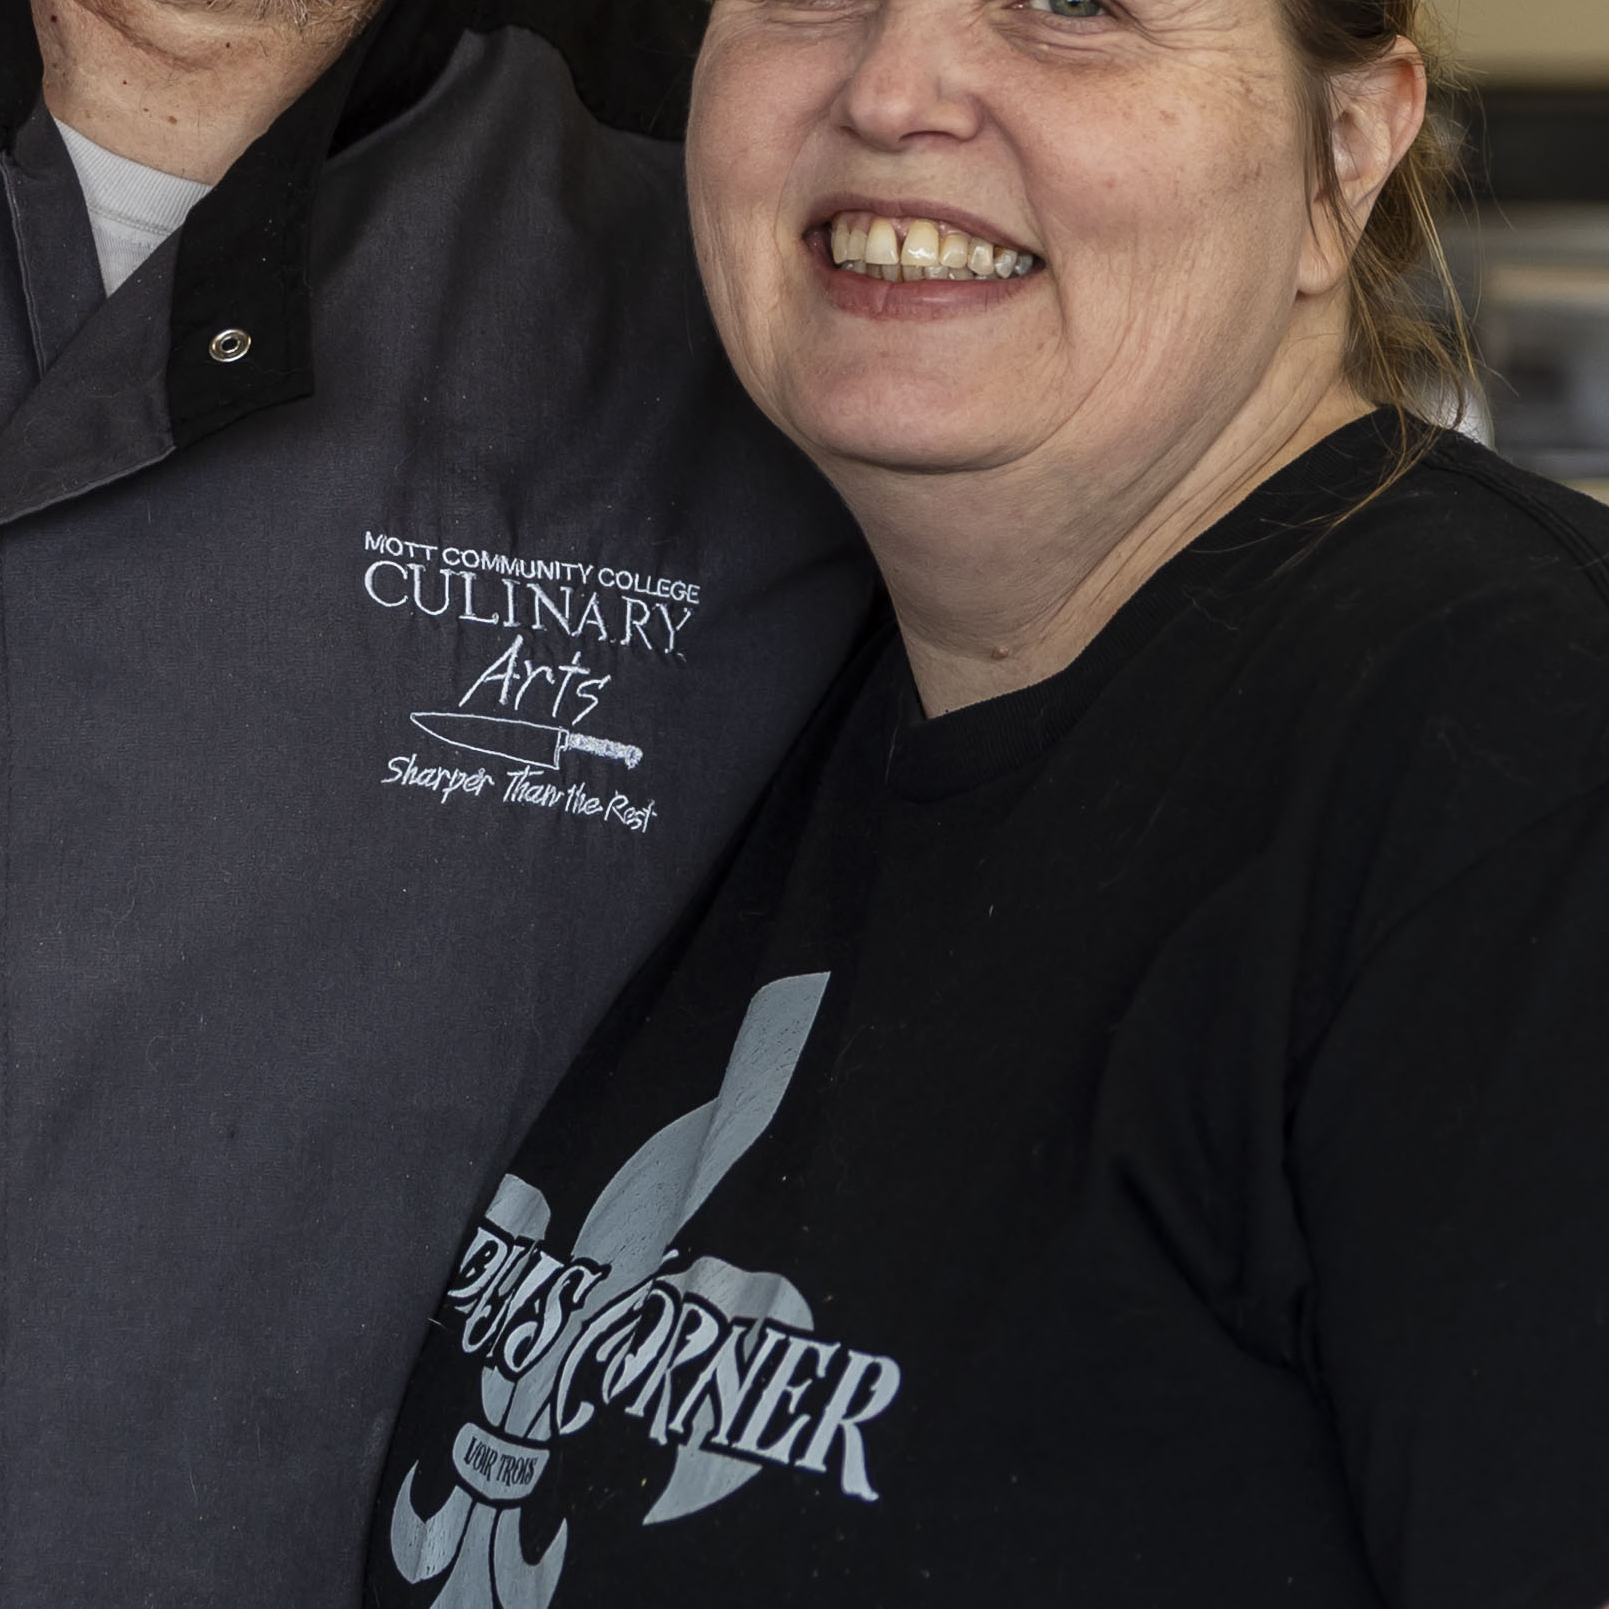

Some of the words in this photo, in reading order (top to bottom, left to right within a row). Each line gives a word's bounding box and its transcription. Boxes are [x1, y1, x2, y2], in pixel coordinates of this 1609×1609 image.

[364, 531, 438, 562] MOTT
[442, 547, 594, 584] COMMUNITY
[598, 567, 701, 605] COLLEGE
[364, 560, 692, 662] CULINARY
[458, 634, 611, 726] Arts
[381, 753, 495, 804] Sharper
[502, 765, 565, 807] Than
[564, 782, 603, 816] the
[603, 790, 657, 833] Rest
[447, 1226, 603, 1374] PUIS
[556, 1250, 902, 1502] CORNER
[463, 1436, 498, 1482] VOIR
[496, 1453, 538, 1487] TROIS
